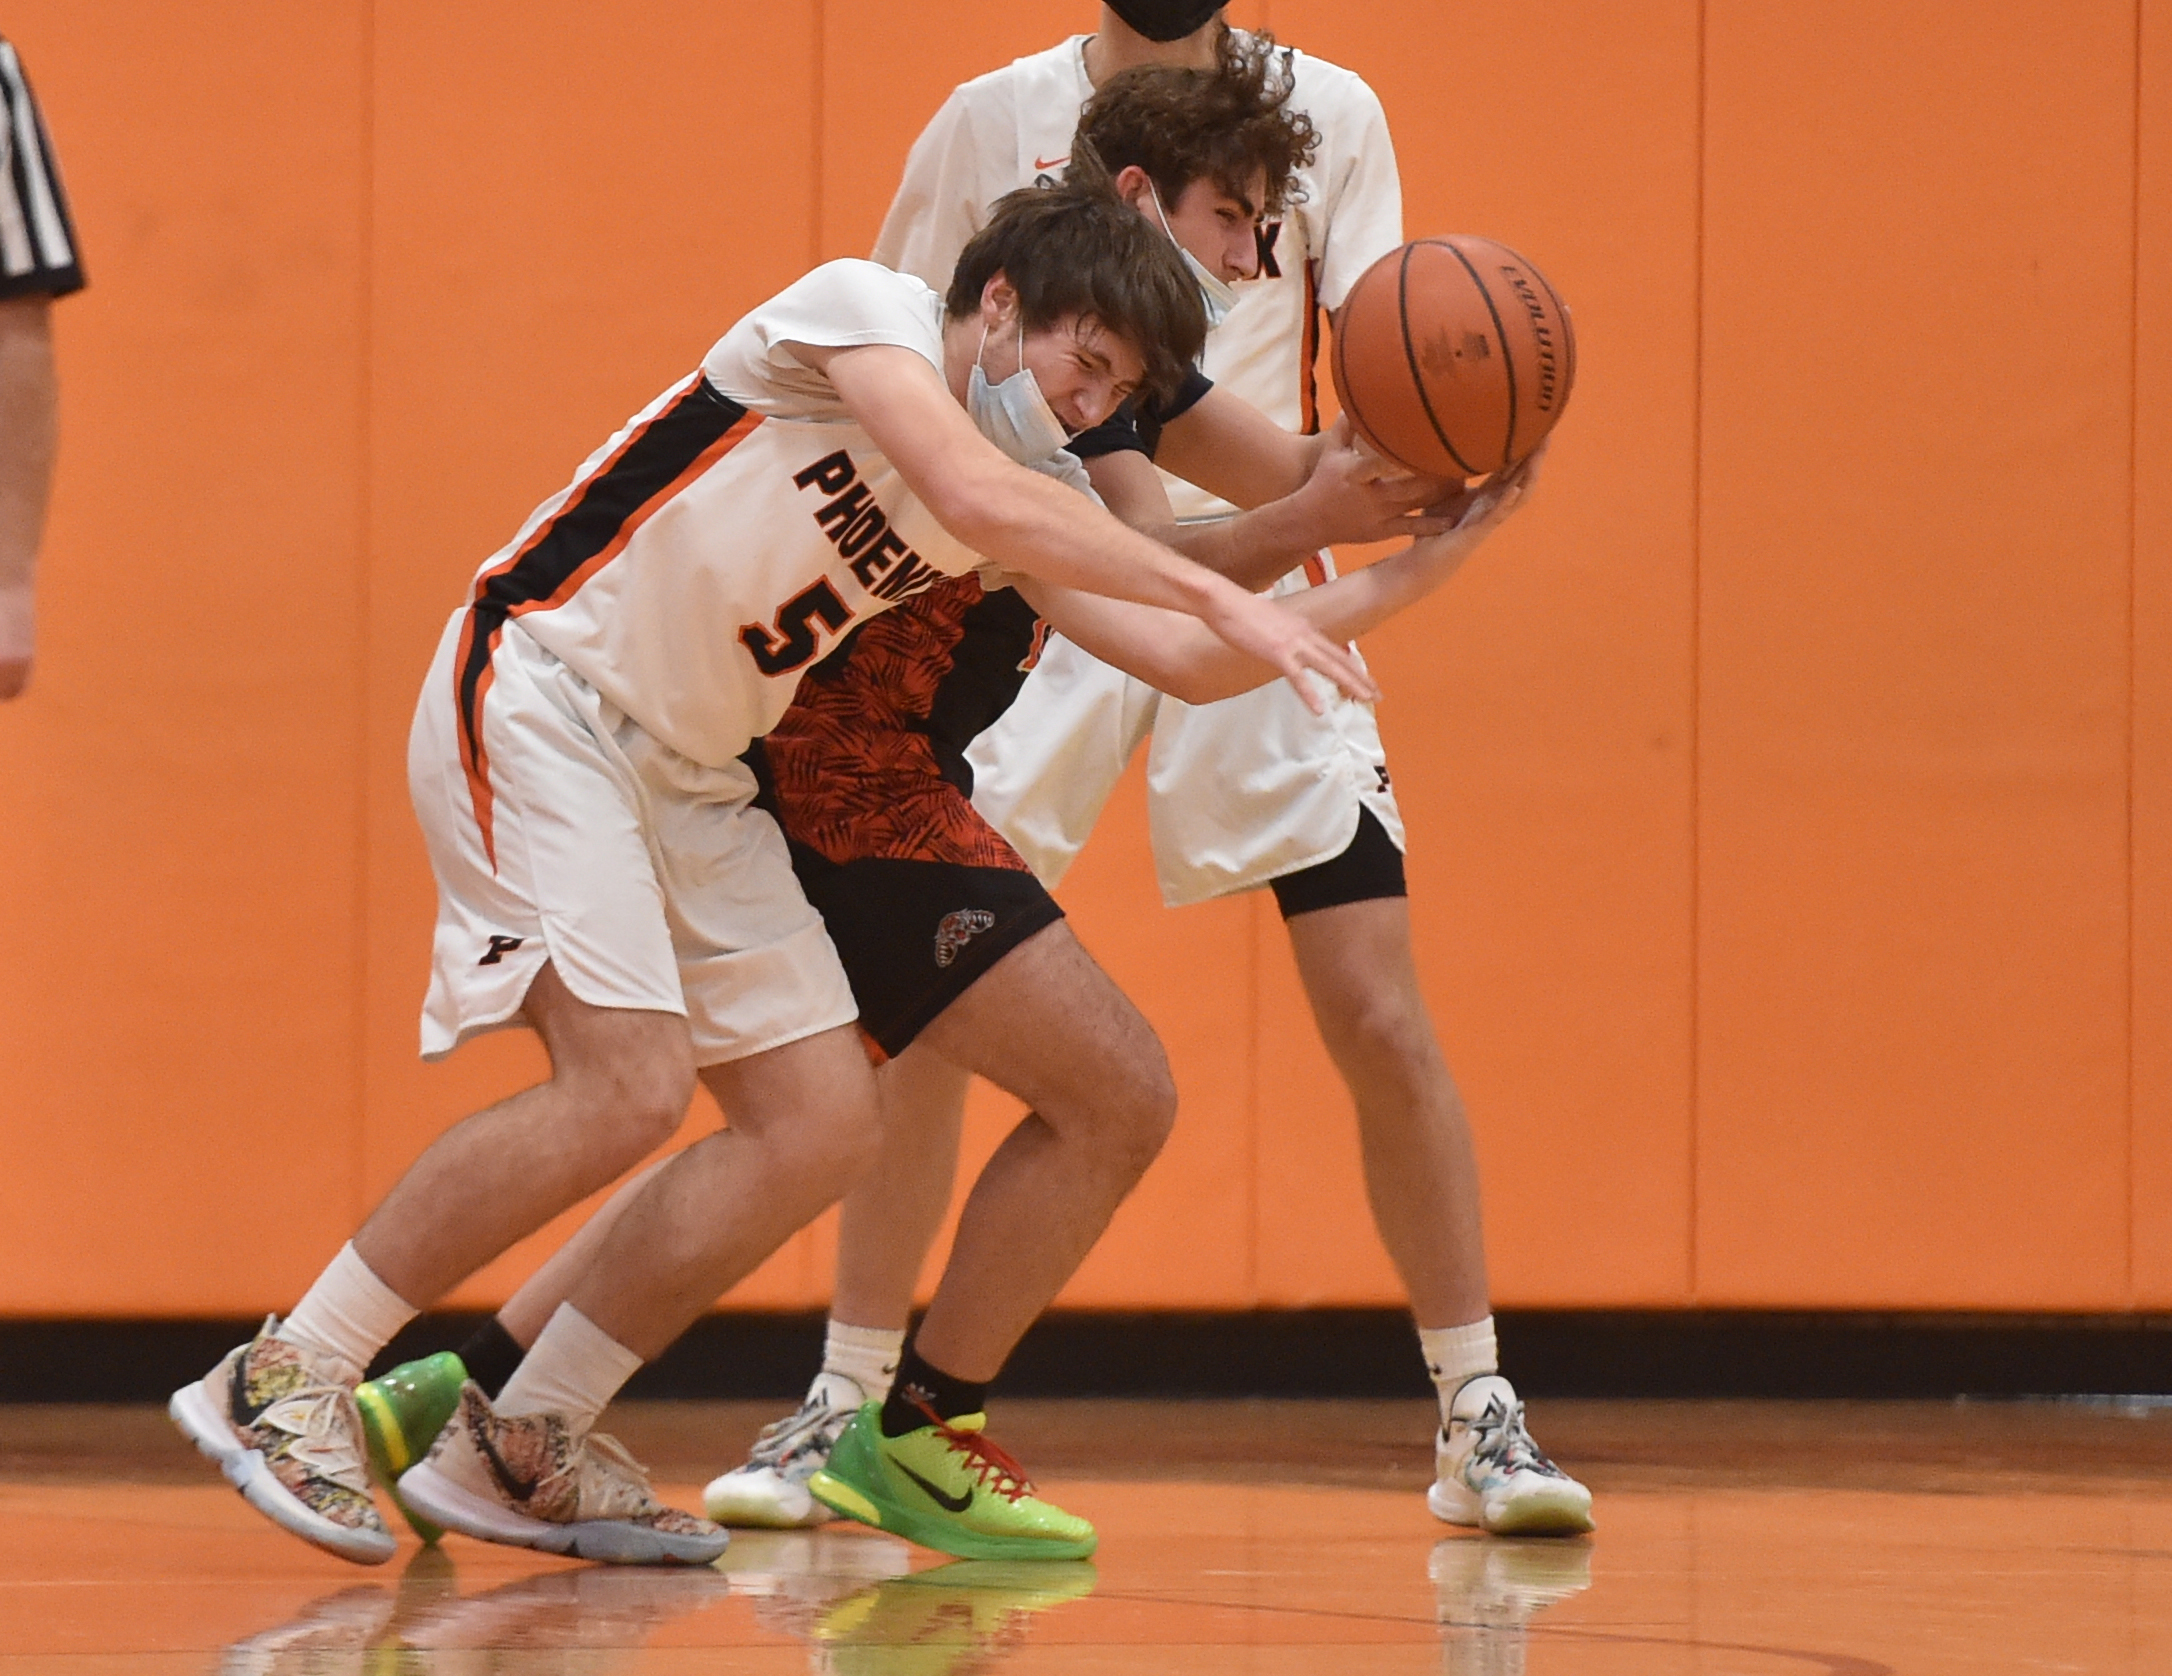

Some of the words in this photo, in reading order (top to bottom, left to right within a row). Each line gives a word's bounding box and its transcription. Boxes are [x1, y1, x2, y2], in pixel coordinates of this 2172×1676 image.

[792, 449, 948, 602] PHOENI
[738, 573, 857, 678] 5
[478, 935, 526, 967] P
